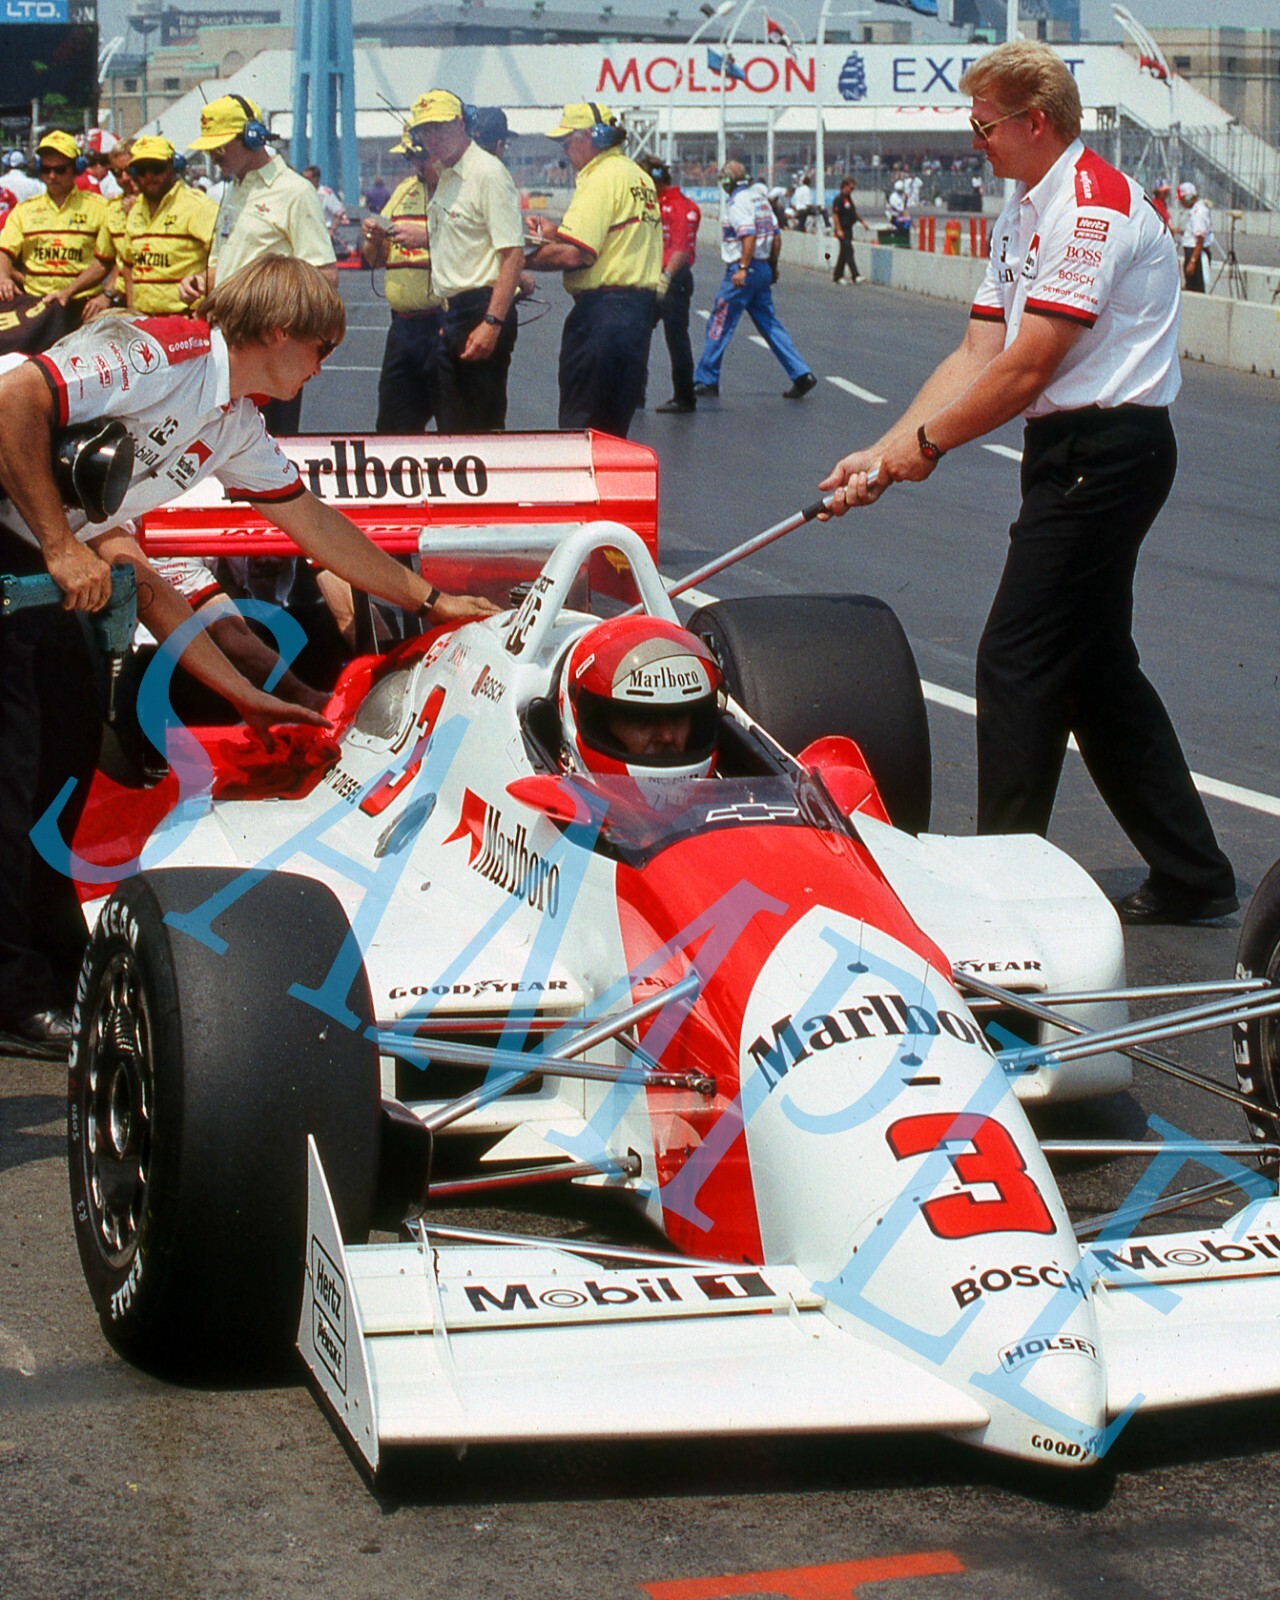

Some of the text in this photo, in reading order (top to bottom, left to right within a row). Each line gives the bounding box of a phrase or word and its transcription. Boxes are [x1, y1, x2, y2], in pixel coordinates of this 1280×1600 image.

[594, 57, 816, 93] MOLSON
[1078, 218, 1107, 231] Hertz
[33, 247, 83, 262] PENNZOIL
[1066, 246, 1102, 262] BOSS
[1042, 285, 1072, 296] DETROIT
[1058, 269, 1096, 286] BOSCH
[480, 675, 507, 704] BOSCH
[628, 667, 700, 689] Marlboro
[472, 804, 560, 919] Marlboro
[389, 980, 569, 1000] GOODYEAR
[885, 1112, 1058, 1240] 3
[316, 1258, 342, 1322] Hertz
[464, 1277, 684, 1313] Mobil
[950, 1264, 1090, 1309] BOSCH
[317, 1313, 342, 1371] PENSKE
[1004, 1336, 1097, 1367] HOLSET
